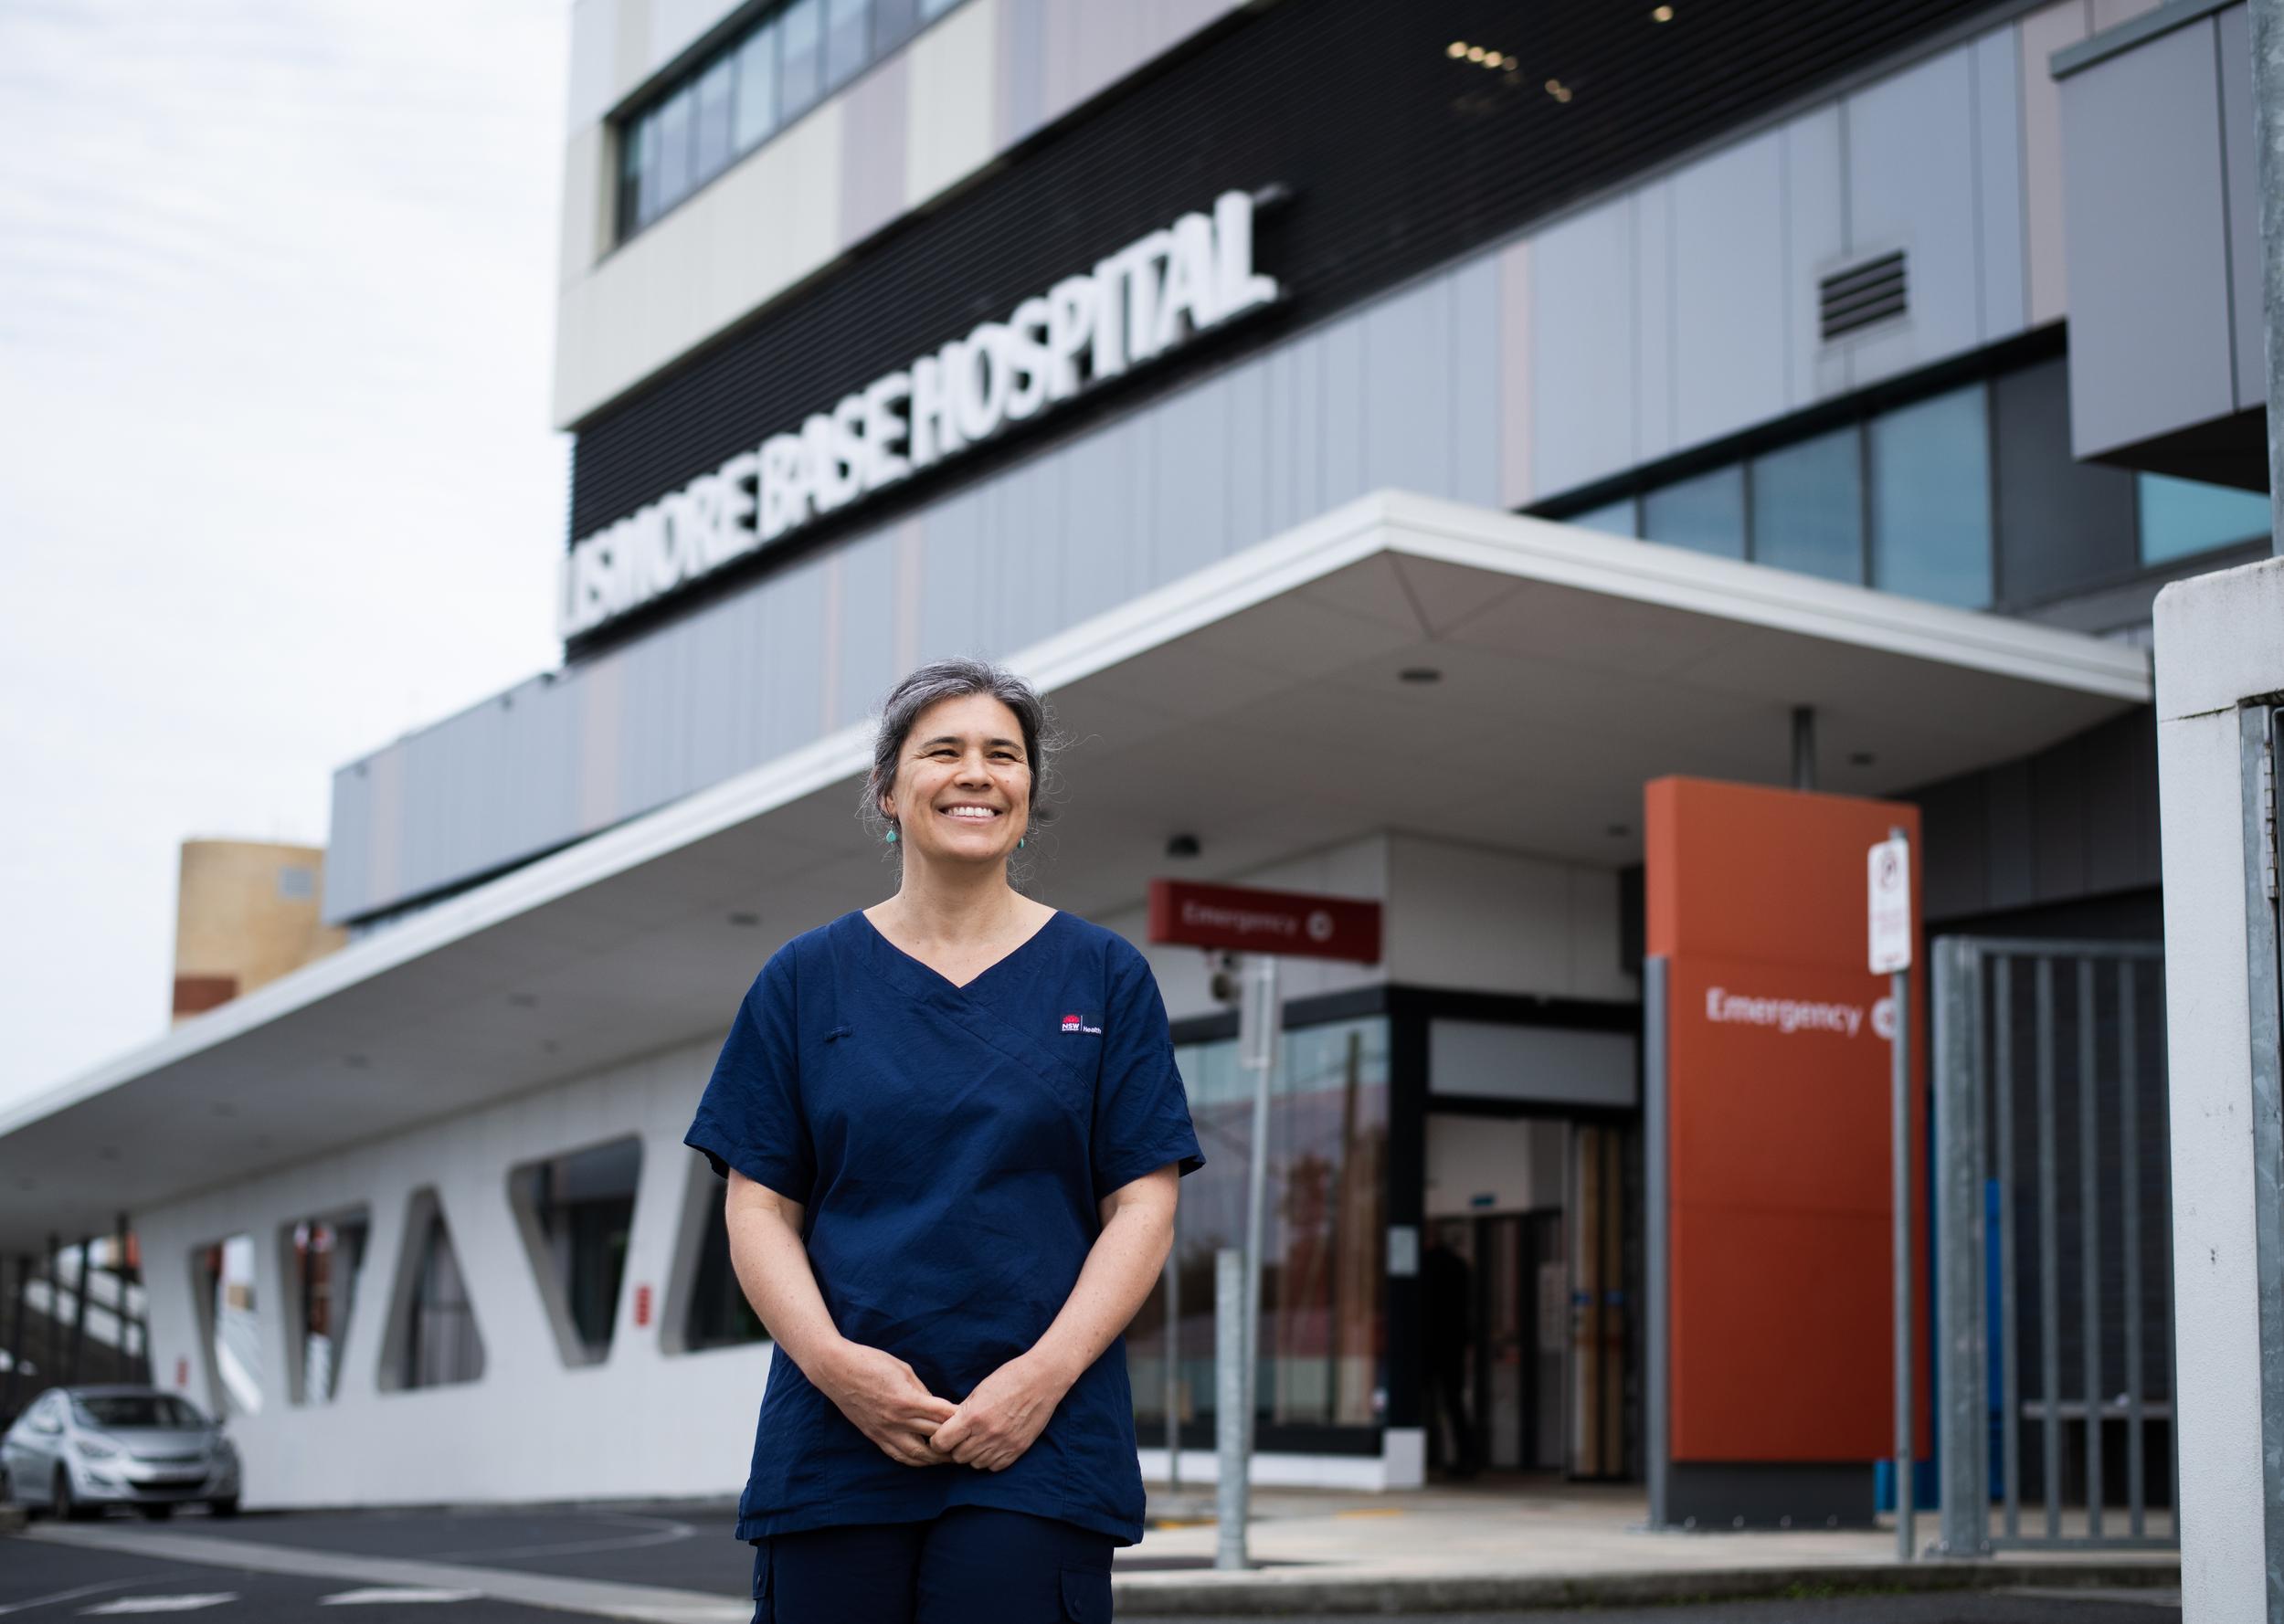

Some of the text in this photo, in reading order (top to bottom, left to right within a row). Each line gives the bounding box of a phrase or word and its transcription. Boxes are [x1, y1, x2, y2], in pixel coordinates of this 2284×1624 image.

[758, 371, 910, 541] BASE
[911, 190, 1278, 468] HOSPITAL
[1182, 901, 1300, 937] Emergency
[1083, 1026, 1102, 1034] Health
[1706, 986, 1863, 1038] Emergency
